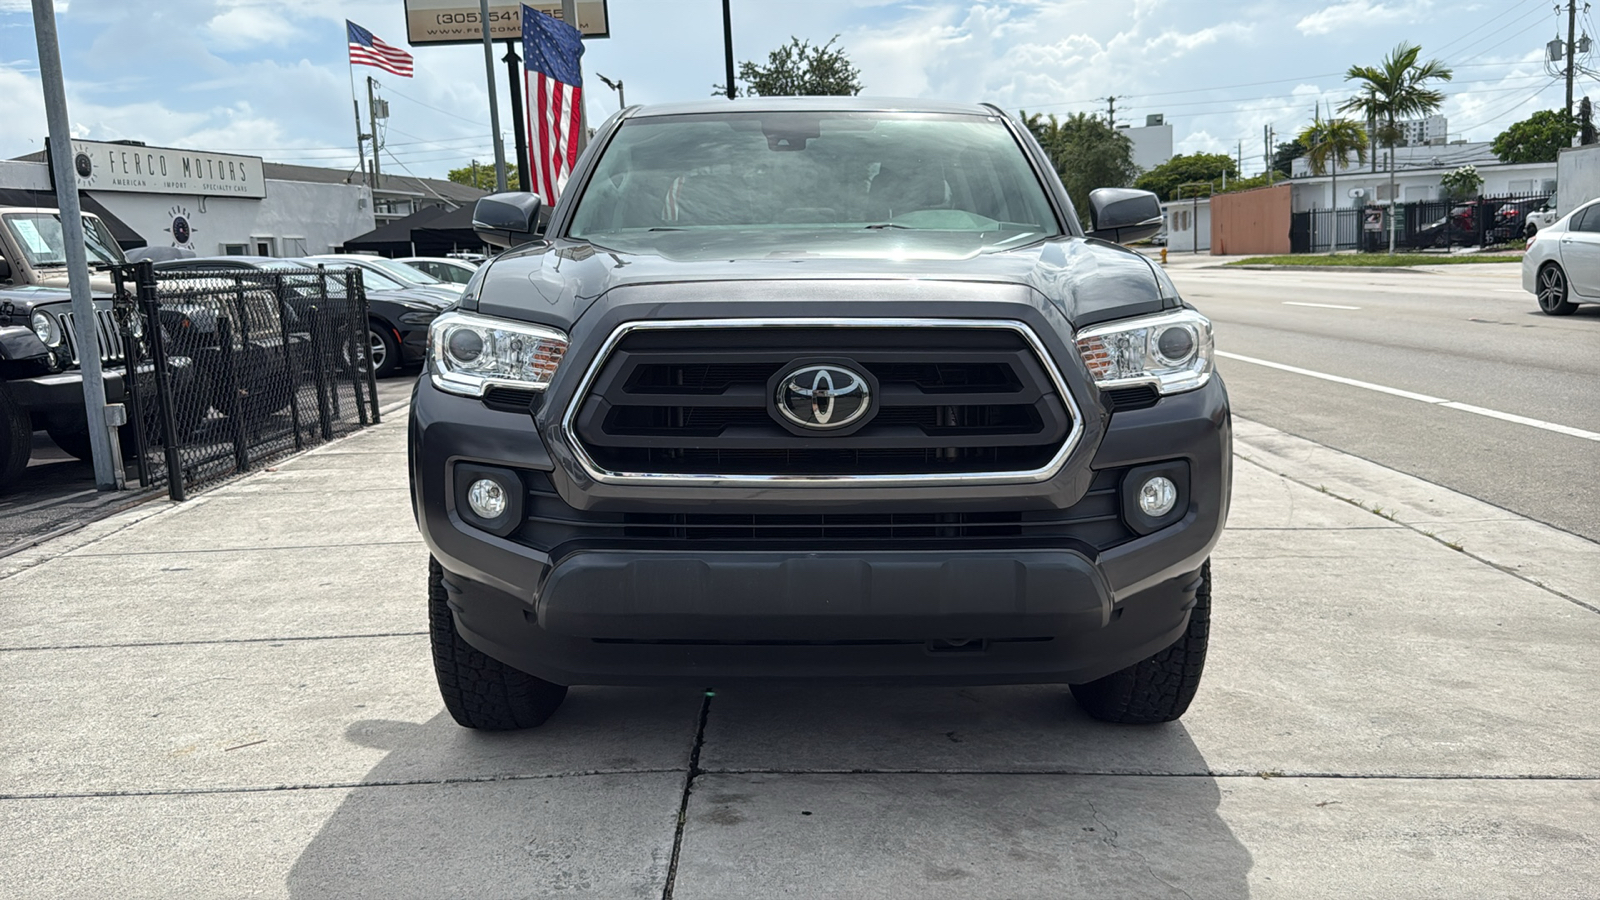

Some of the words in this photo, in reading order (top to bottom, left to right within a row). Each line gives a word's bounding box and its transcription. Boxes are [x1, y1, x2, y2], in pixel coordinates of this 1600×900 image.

[109, 151, 167, 176] FERCO
[182, 157, 246, 182] MOTORS
[112, 178, 147, 187] AMERICAN
[163, 181, 187, 189] IMPORT
[203, 183, 232, 191] SPECIALTY
